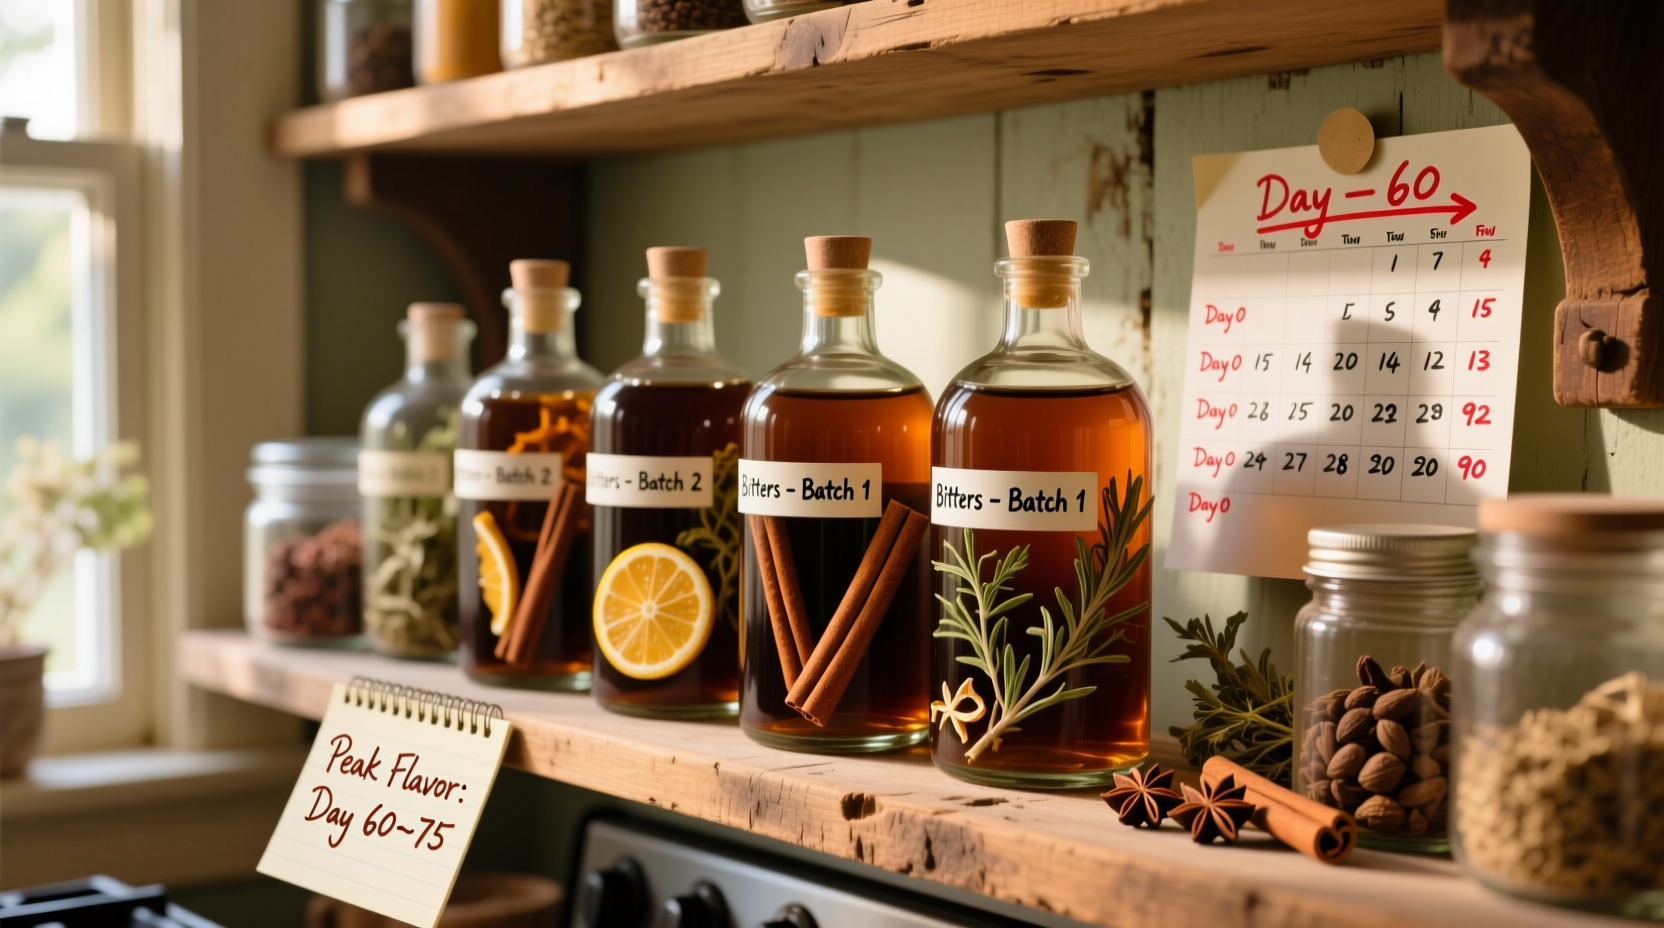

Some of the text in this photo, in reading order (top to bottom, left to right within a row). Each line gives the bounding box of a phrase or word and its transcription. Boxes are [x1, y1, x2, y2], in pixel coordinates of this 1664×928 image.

[1257, 174, 1332, 238] Day
[1387, 160, 1440, 206] 60
[1391, 248, 1491, 272] 1 7 4
[1428, 299, 1440, 321] 4
[1472, 298, 1496, 318] 15
[1255, 353, 1274, 371] 15
[1295, 351, 1311, 373] 14
[1333, 352, 1358, 370] 20
[1379, 351, 1400, 374] 14
[1424, 351, 1445, 371] 12
[1468, 350, 1490, 371] 13
[1329, 403, 1354, 421] 20
[1462, 402, 1492, 427] 92
[541, 468, 551, 485] 2
[1243, 451, 1267, 471] 24
[1282, 452, 1307, 472] 27
[1323, 453, 1349, 475] 28
[1458, 455, 1487, 480] 90
[638, 470, 684, 491] Batch
[691, 472, 702, 491] 2
[742, 474, 781, 498] Bitters
[802, 477, 854, 500] Batch
[861, 478, 871, 500] 1
[936, 483, 983, 510] Bitters
[1008, 487, 1067, 512] Batch
[1076, 489, 1086, 512] 1
[326, 733, 467, 803] Peak Flavor:
[304, 785, 354, 848] Day
